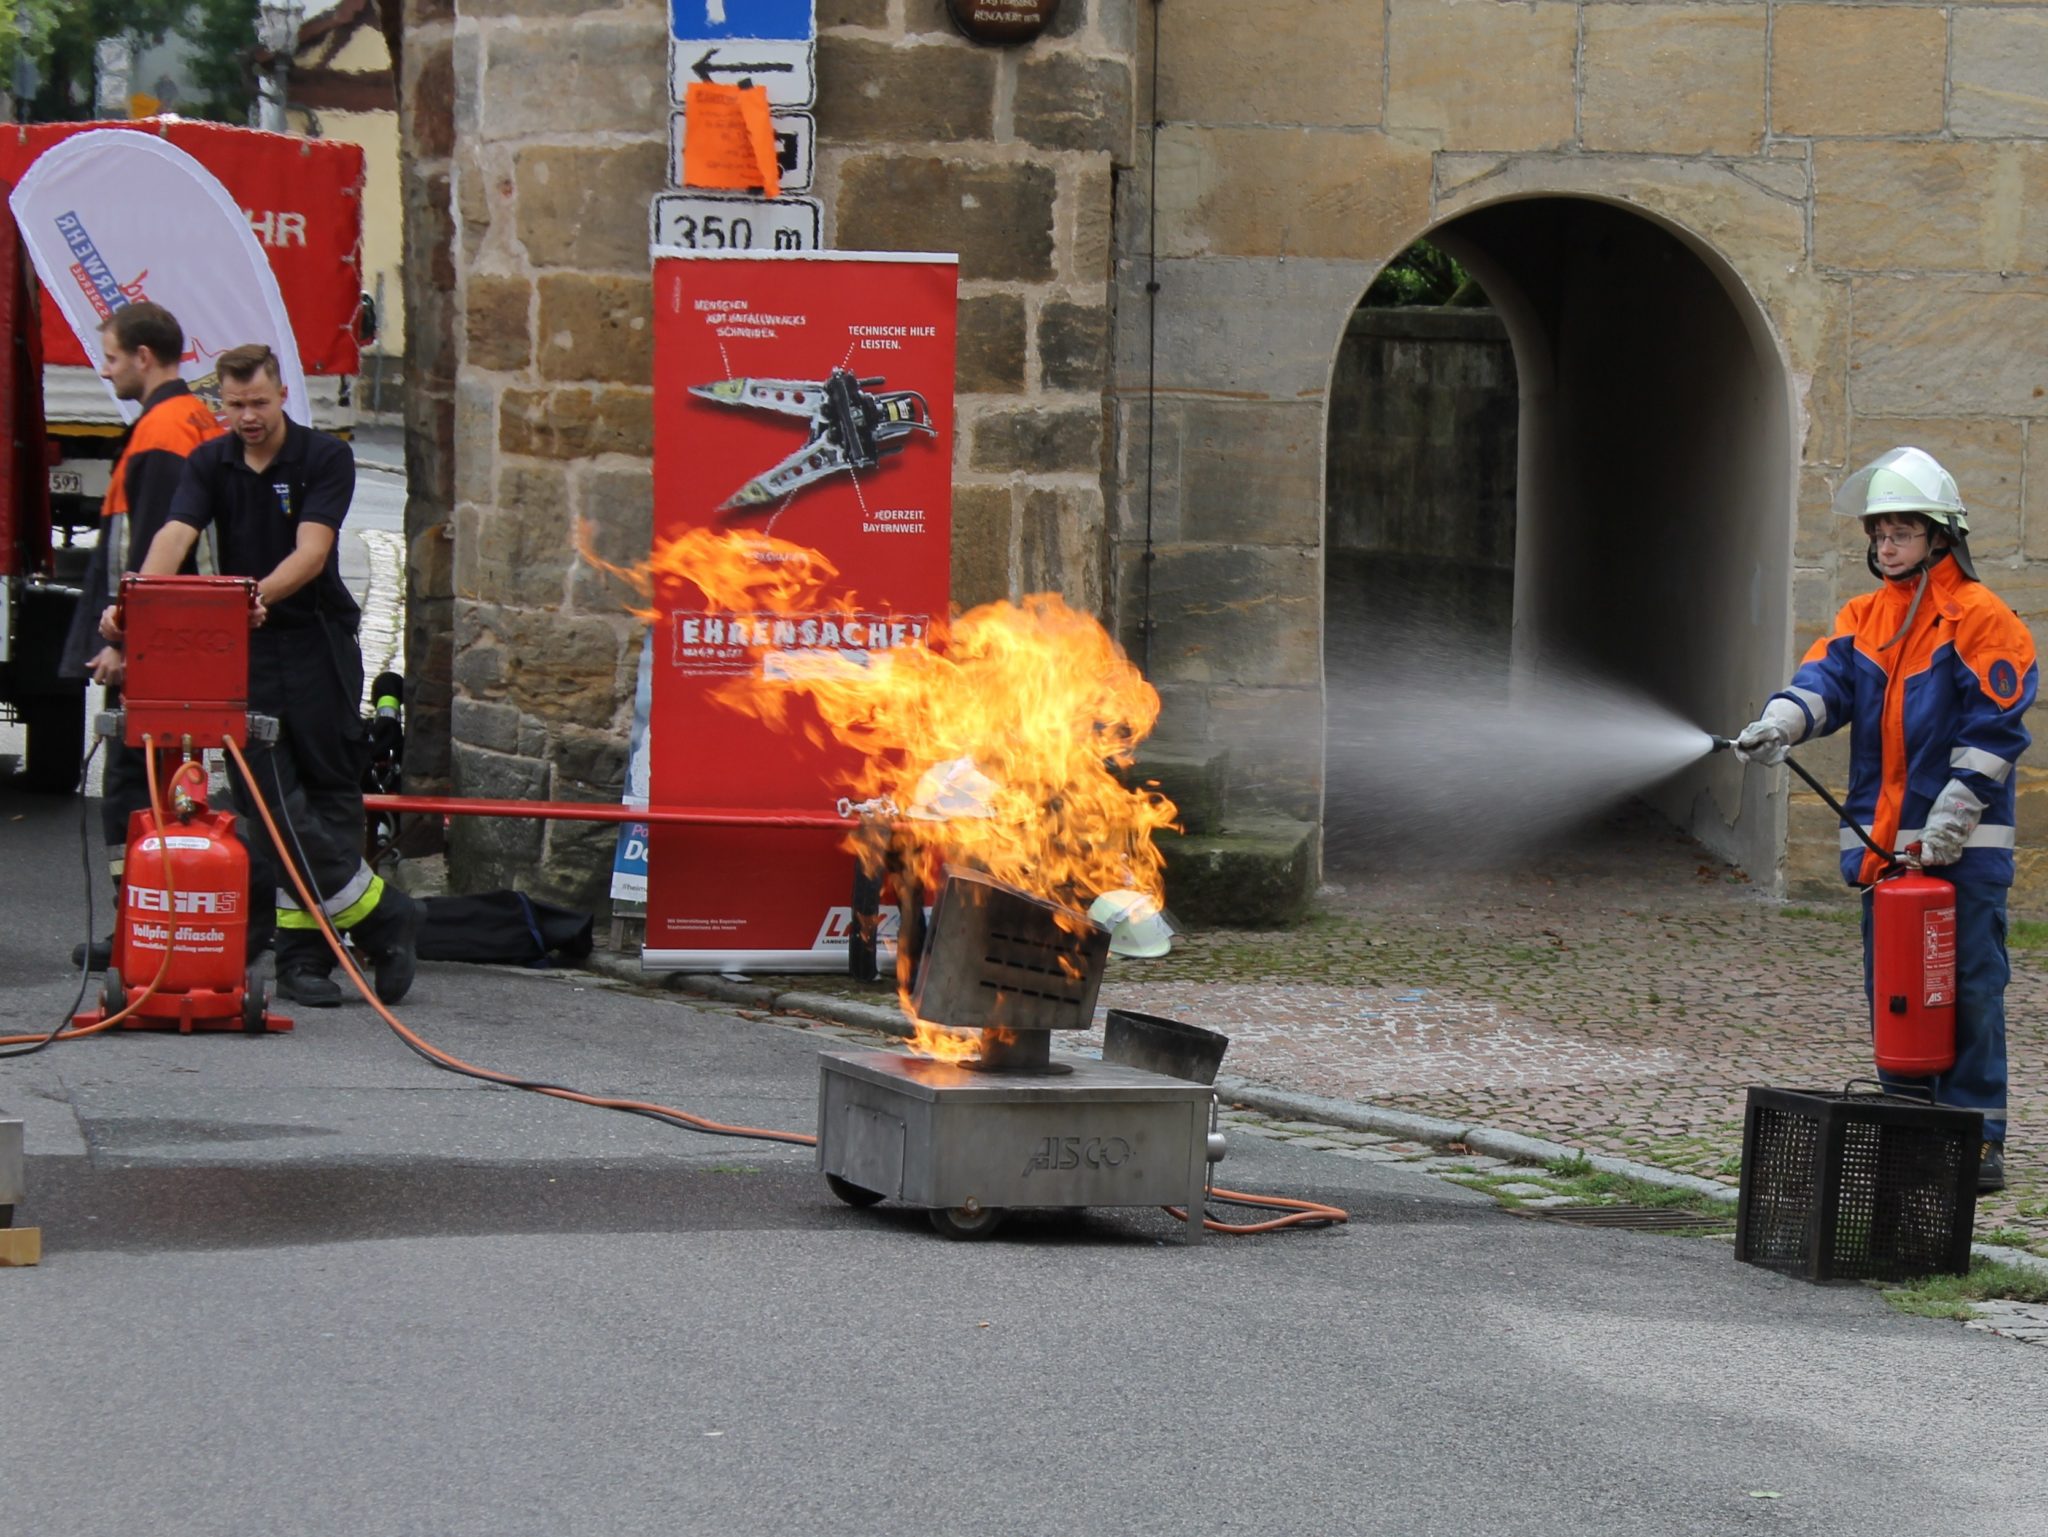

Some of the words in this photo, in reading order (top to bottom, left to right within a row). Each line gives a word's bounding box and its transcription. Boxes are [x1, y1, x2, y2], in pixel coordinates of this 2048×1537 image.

[244, 210, 307, 248] HR
[674, 215, 752, 249] 350
[694, 299, 748, 311] MENSCHEN
[848, 326, 907, 338] TECHNISCHE
[909, 327, 937, 338] HILFE
[860, 339, 902, 350] LEISTEN.
[874, 509, 926, 521] JEDERZEIT.
[862, 522, 926, 534] BAYERNWEIT.
[682, 618, 922, 649] EHRENSACHE!
[127, 885, 237, 914] TEGAS
[132, 922, 225, 942] Vollpfadflasche
